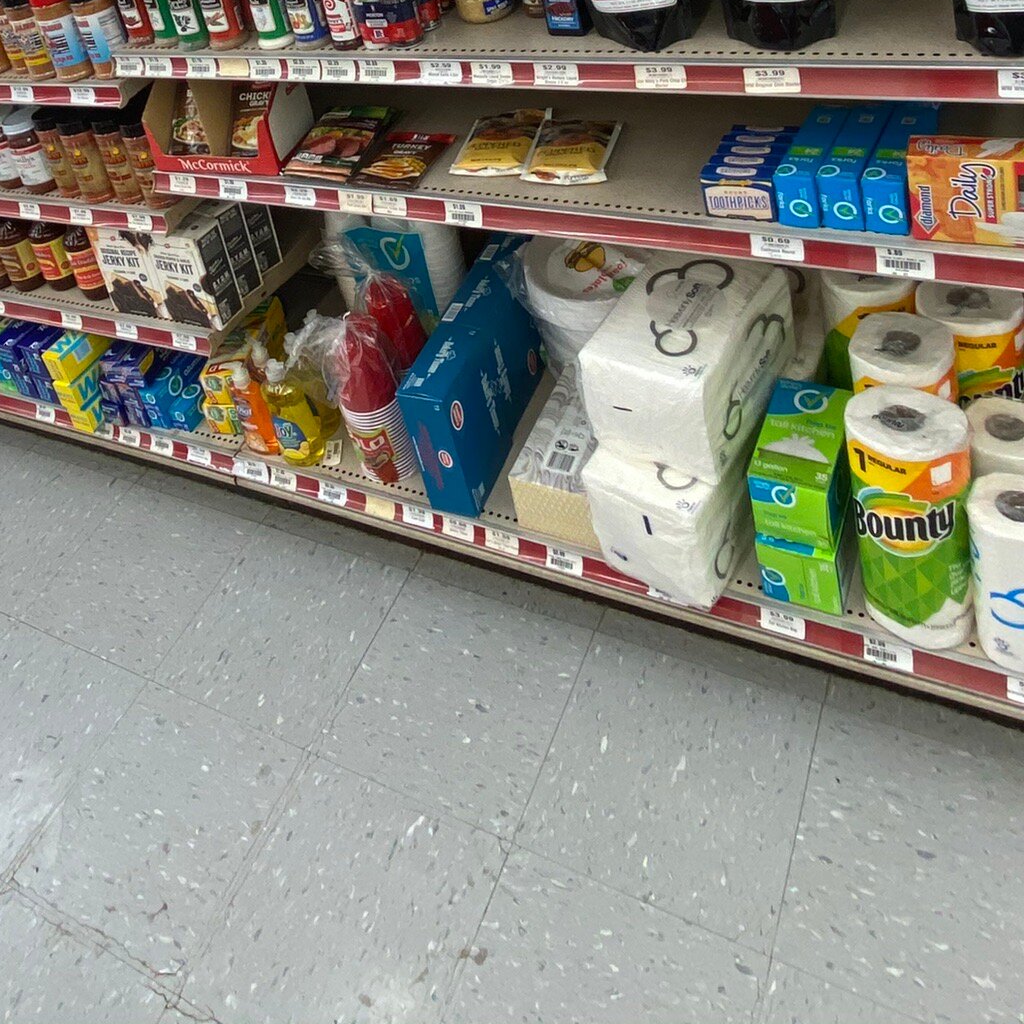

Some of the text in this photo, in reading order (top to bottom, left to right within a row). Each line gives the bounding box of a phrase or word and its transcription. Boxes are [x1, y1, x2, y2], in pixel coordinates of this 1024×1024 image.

[239, 91, 271, 101] CHICK
[392, 142, 432, 151] TURKEY
[178, 158, 252, 174] McCormick
[708, 194, 769, 211] TOOTHPICKS
[821, 193, 829, 212] forks
[866, 196, 874, 215] forks
[918, 185, 933, 225] diamond
[987, 200, 995, 218] SUPER
[762, 236, 791, 244] $0.69
[102, 255, 140, 268] JERKY KIT
[156, 260, 194, 276] JERKY KIT
[762, 460, 789, 473] gallon
[867, 454, 907, 476] REGULAR
[854, 496, 956, 543] Bounty
